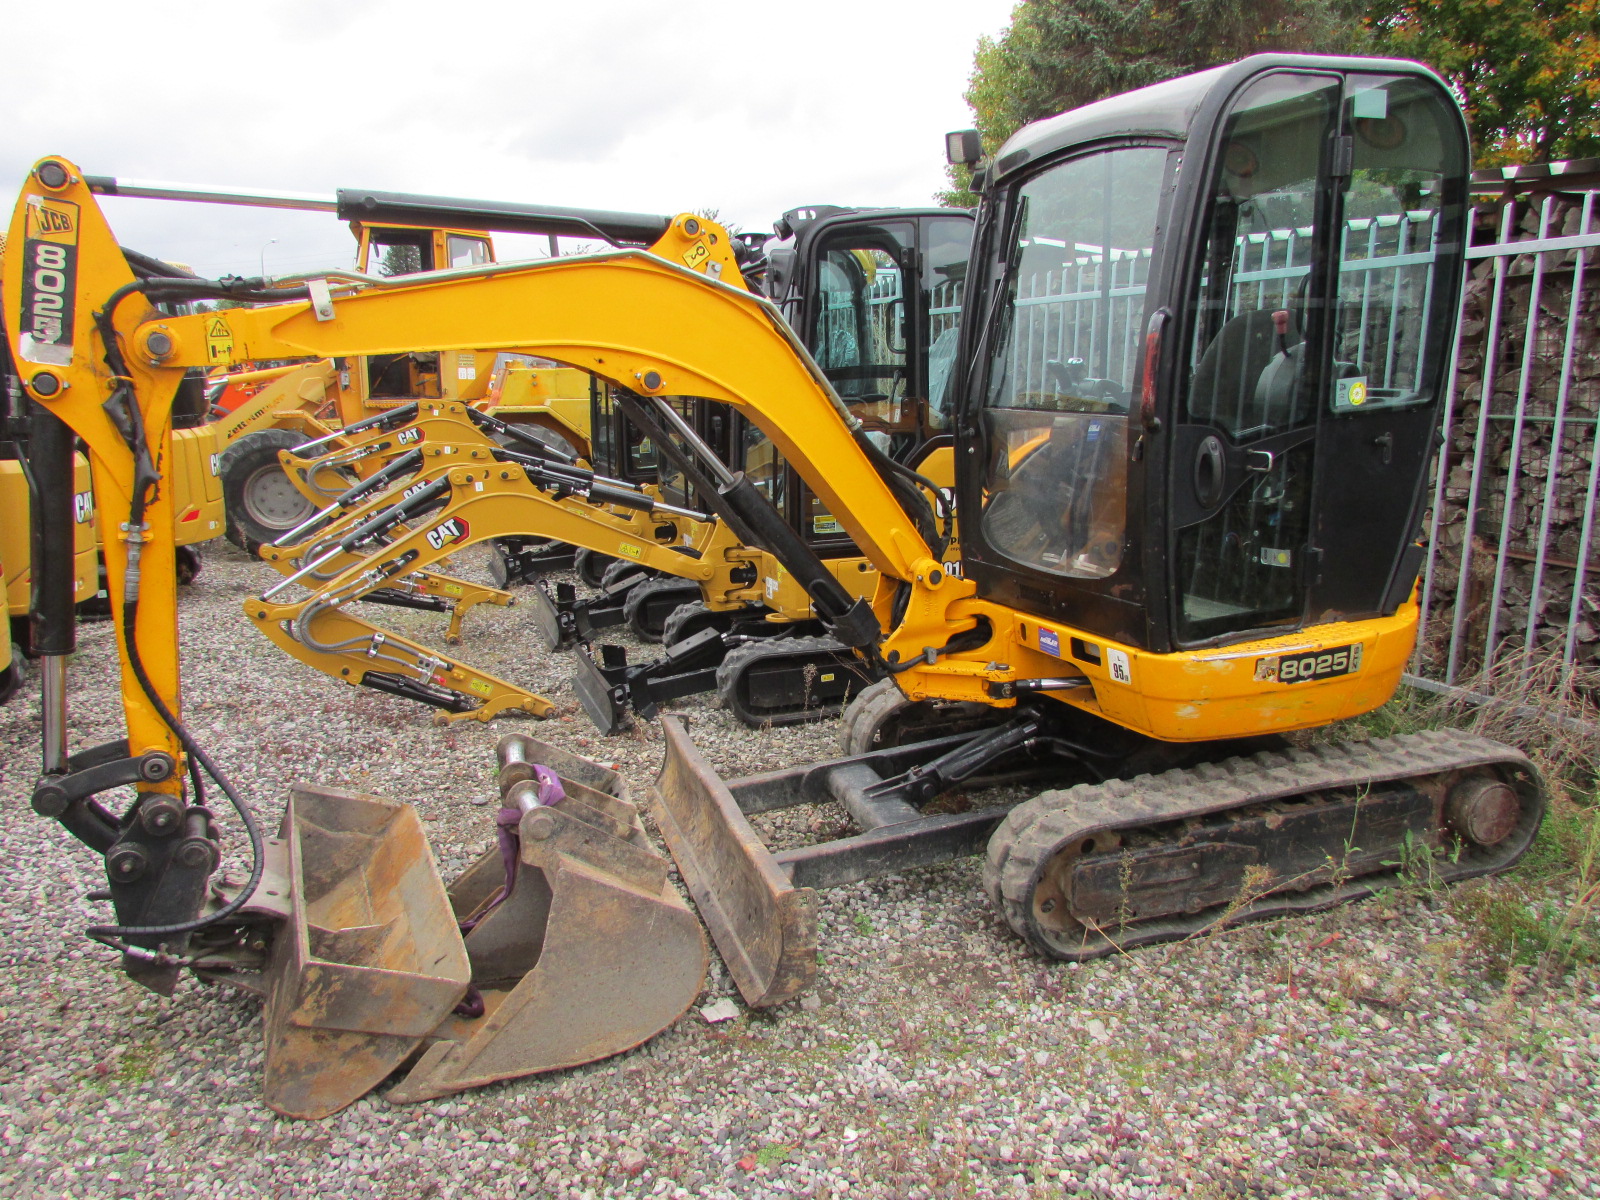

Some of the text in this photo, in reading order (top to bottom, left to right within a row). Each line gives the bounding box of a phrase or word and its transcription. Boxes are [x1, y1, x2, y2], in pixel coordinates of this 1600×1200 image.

[40, 207, 71, 232] JCB
[32, 243, 67, 344] 8025
[397, 428, 419, 445] CAT
[426, 518, 461, 550] CAT
[1112, 663, 1124, 681] 95
[1280, 652, 1348, 679] 8025
